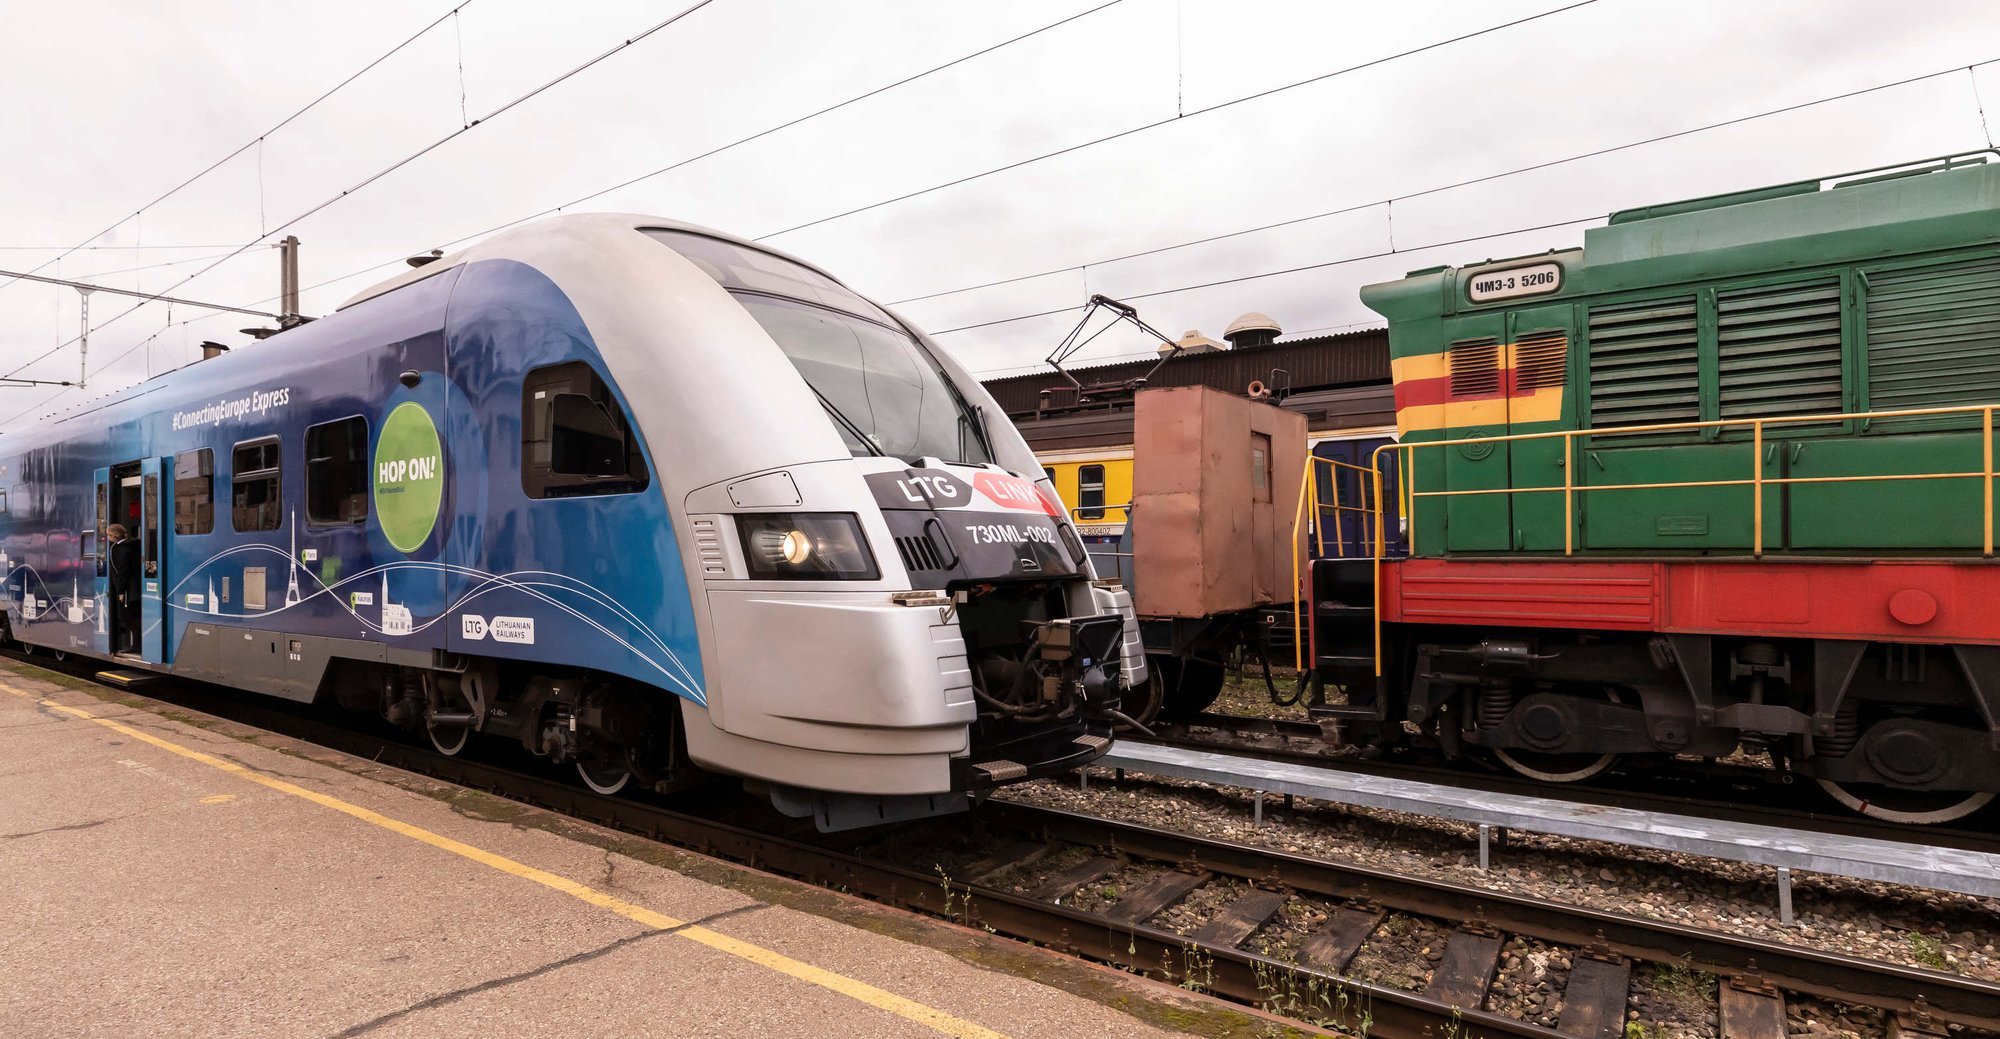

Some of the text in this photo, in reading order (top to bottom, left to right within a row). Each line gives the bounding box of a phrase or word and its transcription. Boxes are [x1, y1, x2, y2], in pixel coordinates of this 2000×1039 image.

[1476, 271, 1554, 293] ЧМЭ-3 5206
[172, 387, 290, 432] #ConnectingEurope Express
[379, 455, 436, 484] HOP ON!
[897, 476, 1041, 503] LTG LINK
[965, 524, 1056, 545] 730ML-002
[465, 620, 482, 634] LTG
[495, 621, 531, 631] LITHUANIAN
[496, 630, 525, 639] RAILWAYS
